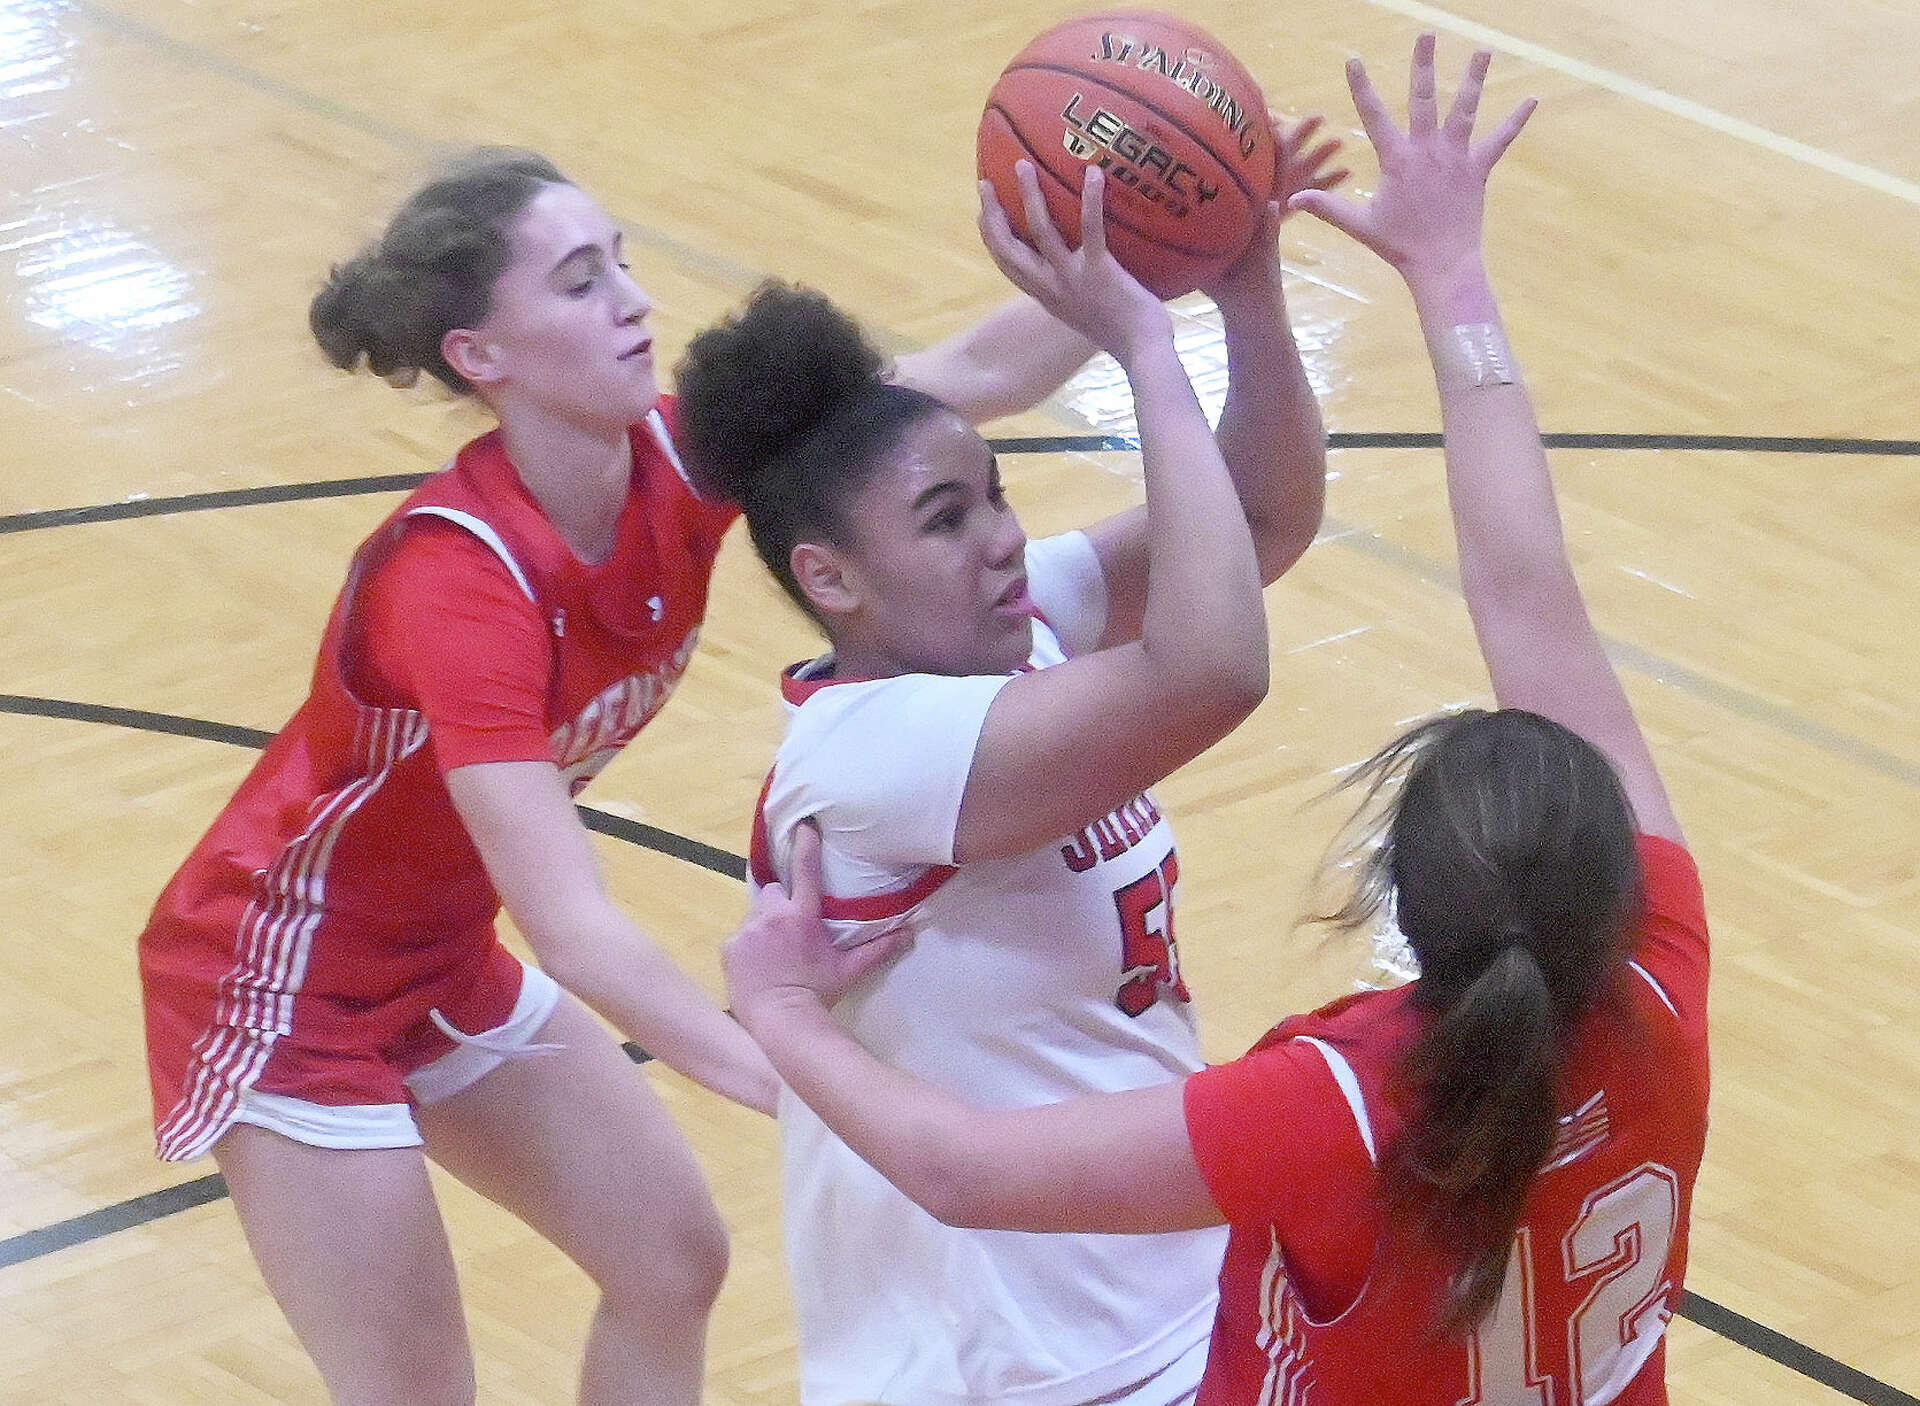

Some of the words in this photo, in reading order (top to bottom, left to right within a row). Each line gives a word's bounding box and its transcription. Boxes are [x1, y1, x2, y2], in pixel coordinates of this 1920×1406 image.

[1060, 92, 1221, 203] LEGACY
[1091, 32, 1256, 161] SPALDING
[1456, 1162, 1679, 1406] 12
